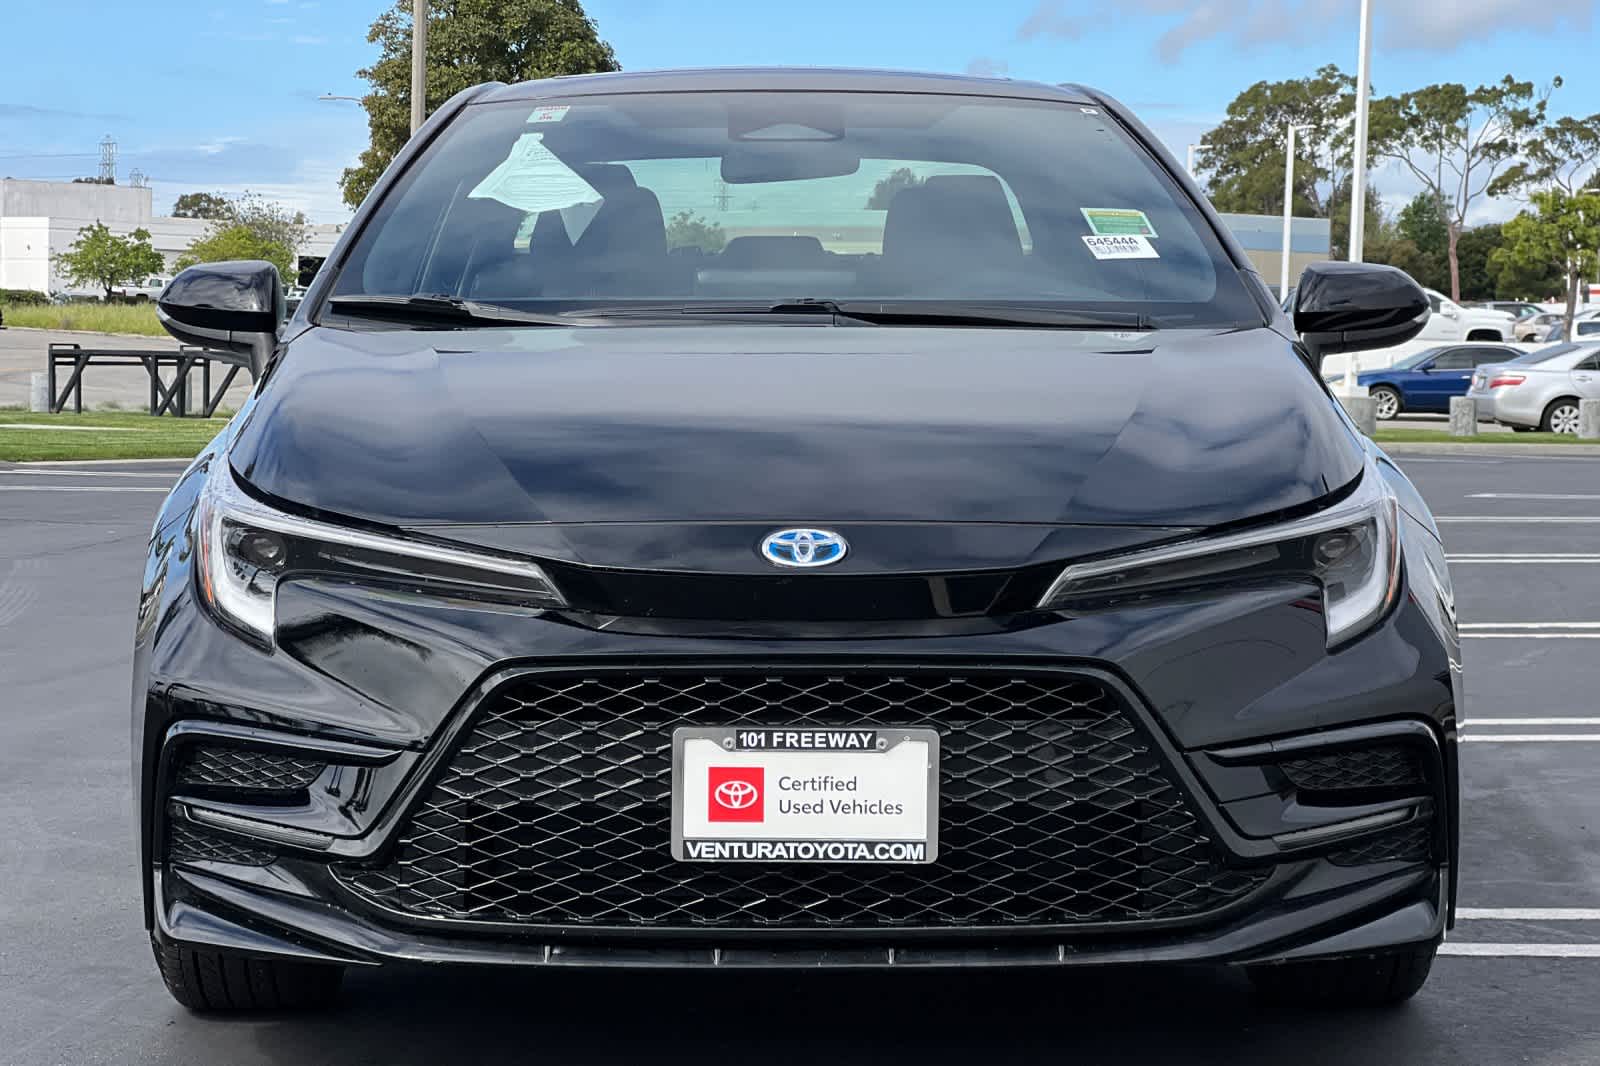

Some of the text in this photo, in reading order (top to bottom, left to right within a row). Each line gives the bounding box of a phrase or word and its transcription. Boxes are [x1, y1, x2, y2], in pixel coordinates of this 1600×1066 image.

[1086, 237, 1138, 246] 64544A
[739, 732, 873, 748] 101 FREEWAY
[778, 775, 857, 792] Certified
[779, 798, 903, 815] Used Vehicles
[686, 841, 924, 860] VENTURATOYOTA.COM
